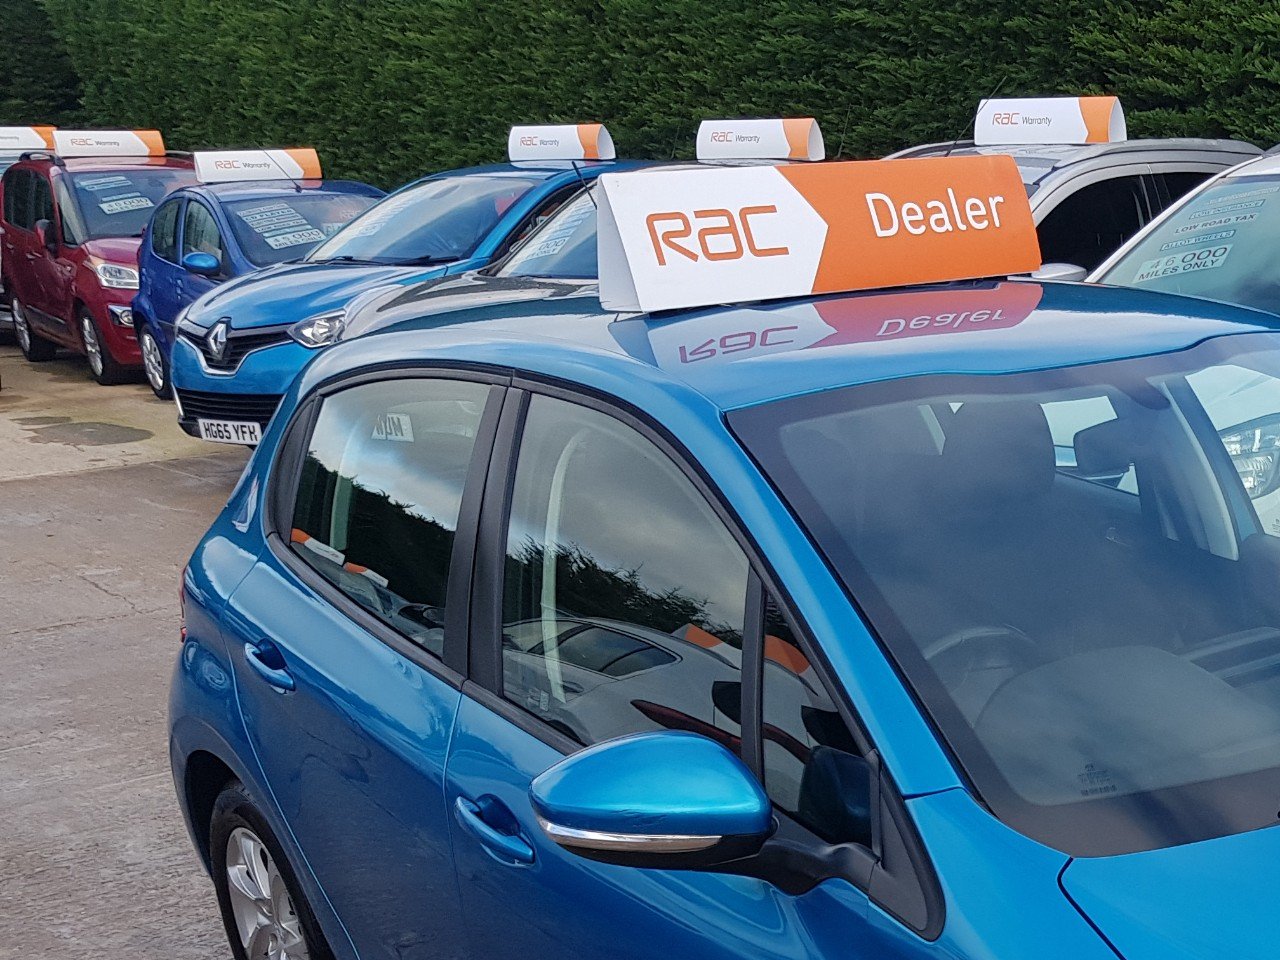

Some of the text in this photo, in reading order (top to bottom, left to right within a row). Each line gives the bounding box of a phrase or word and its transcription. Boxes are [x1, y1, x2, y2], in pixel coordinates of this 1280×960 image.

[1021, 116, 1052, 127] Warranty
[735, 133, 761, 144] Warranty
[242, 162, 271, 170] Warranty
[864, 187, 1005, 238] Dealer
[1174, 213, 1257, 234] LOW ROAD TAX
[1138, 258, 1220, 281] MILES ONLY
[202, 421, 232, 440] HG65
